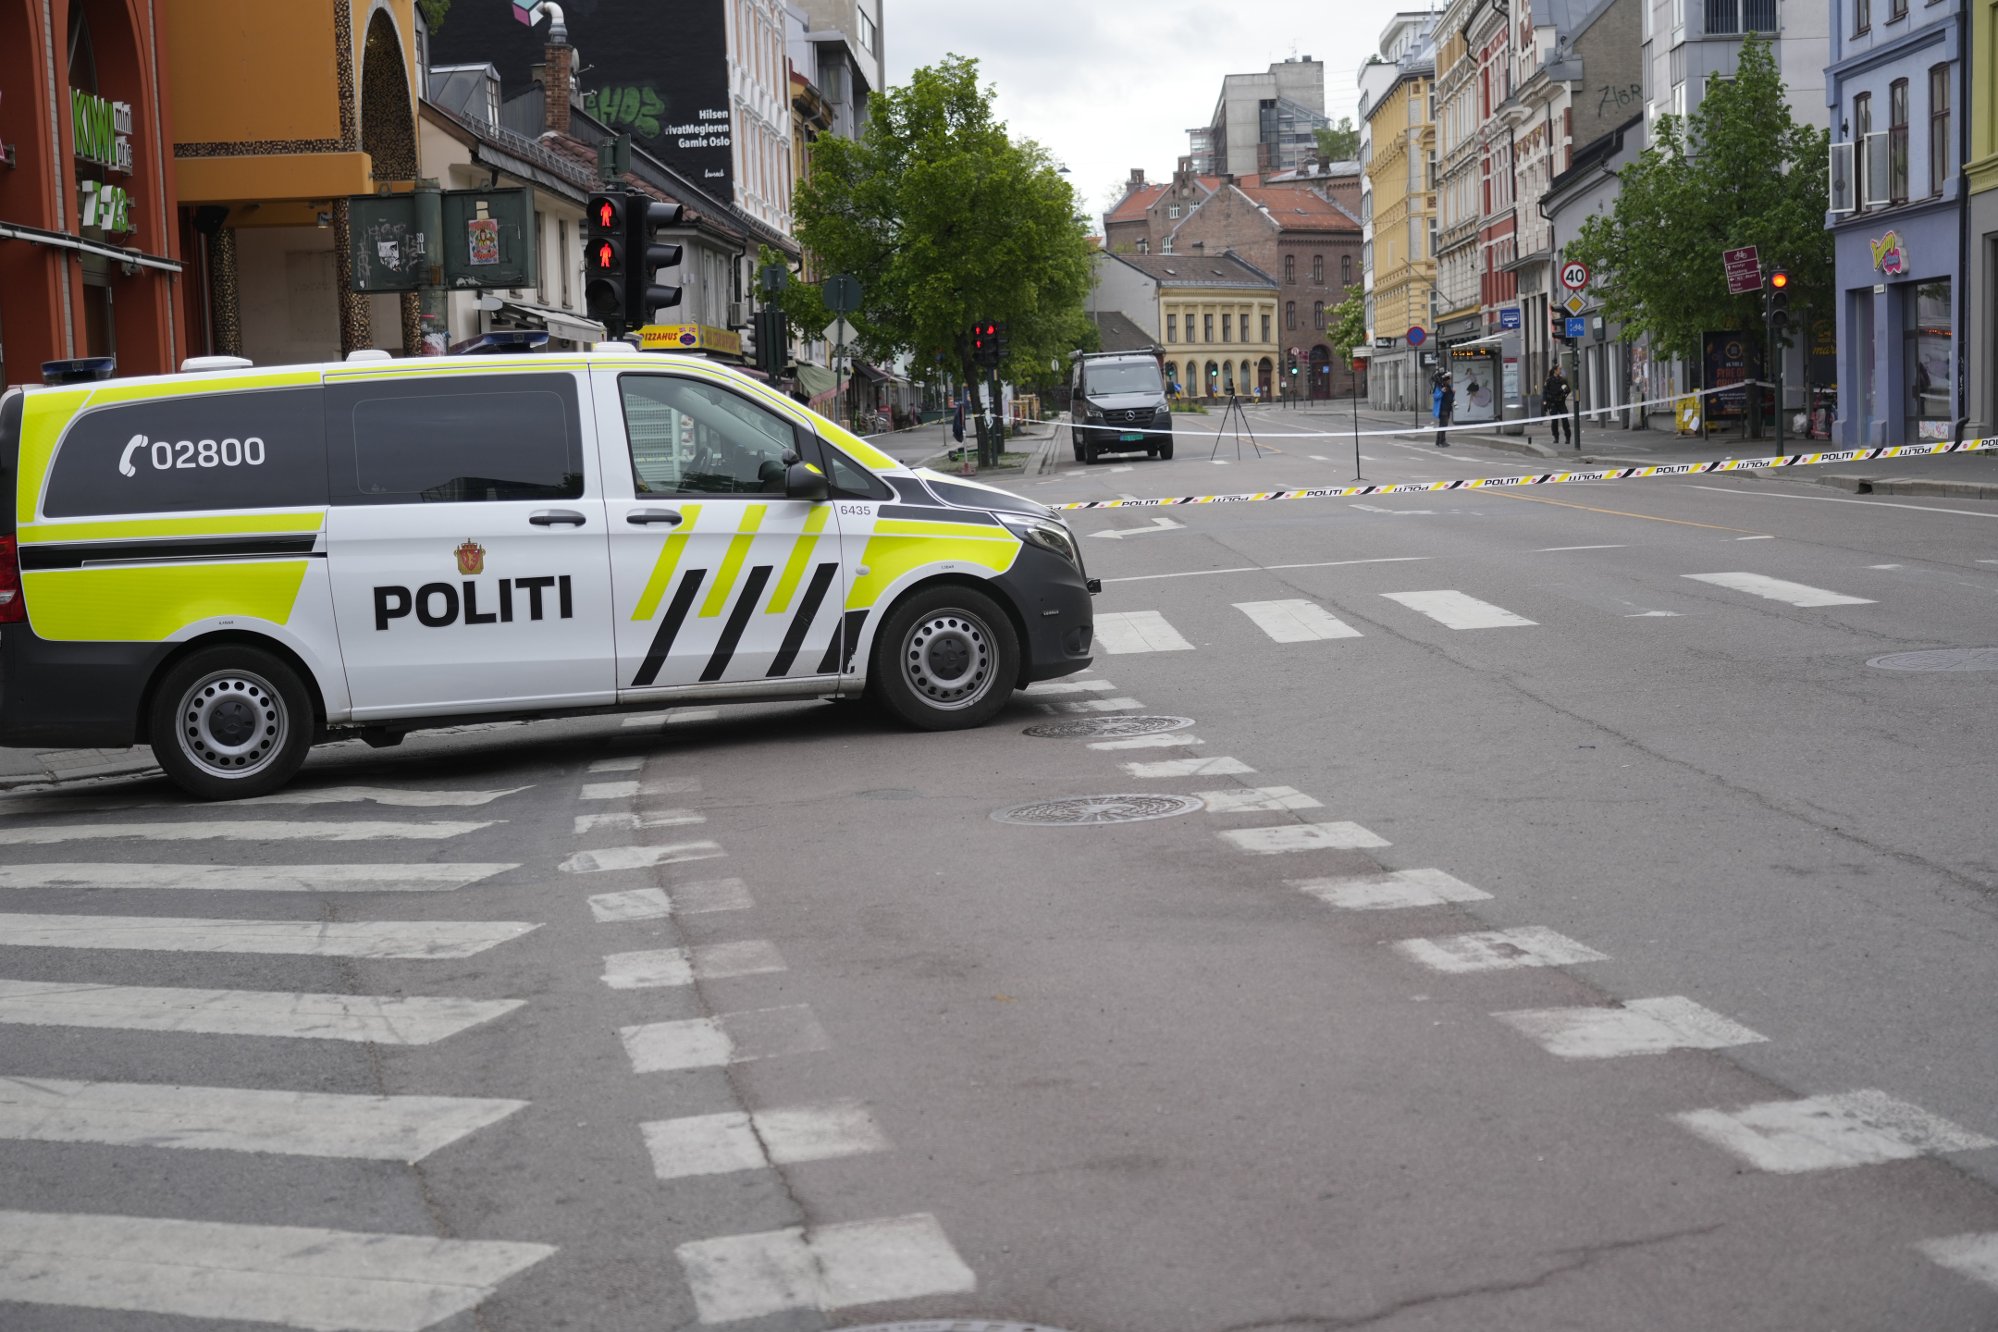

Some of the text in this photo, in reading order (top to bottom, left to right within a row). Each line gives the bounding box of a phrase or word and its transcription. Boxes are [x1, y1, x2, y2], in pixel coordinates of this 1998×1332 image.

[115, 103, 132, 132] mini
[699, 109, 729, 120] Hilsen
[71, 89, 118, 166] KIWI
[665, 123, 729, 136] rivatMegleren
[678, 136, 730, 148] Gamle Oslo
[82, 180, 129, 233] 7-23
[1566, 269, 1585, 283] 40
[1981, 439, 1998, 447] POL
[151, 437, 266, 470] 02800
[1821, 451, 1854, 461] POLITI
[1655, 465, 1689, 474] POLITI
[1484, 477, 1519, 486] POLITI
[1306, 489, 1343, 497] POLITI
[840, 505, 871, 515] 6435
[374, 575, 573, 631] POLITI
